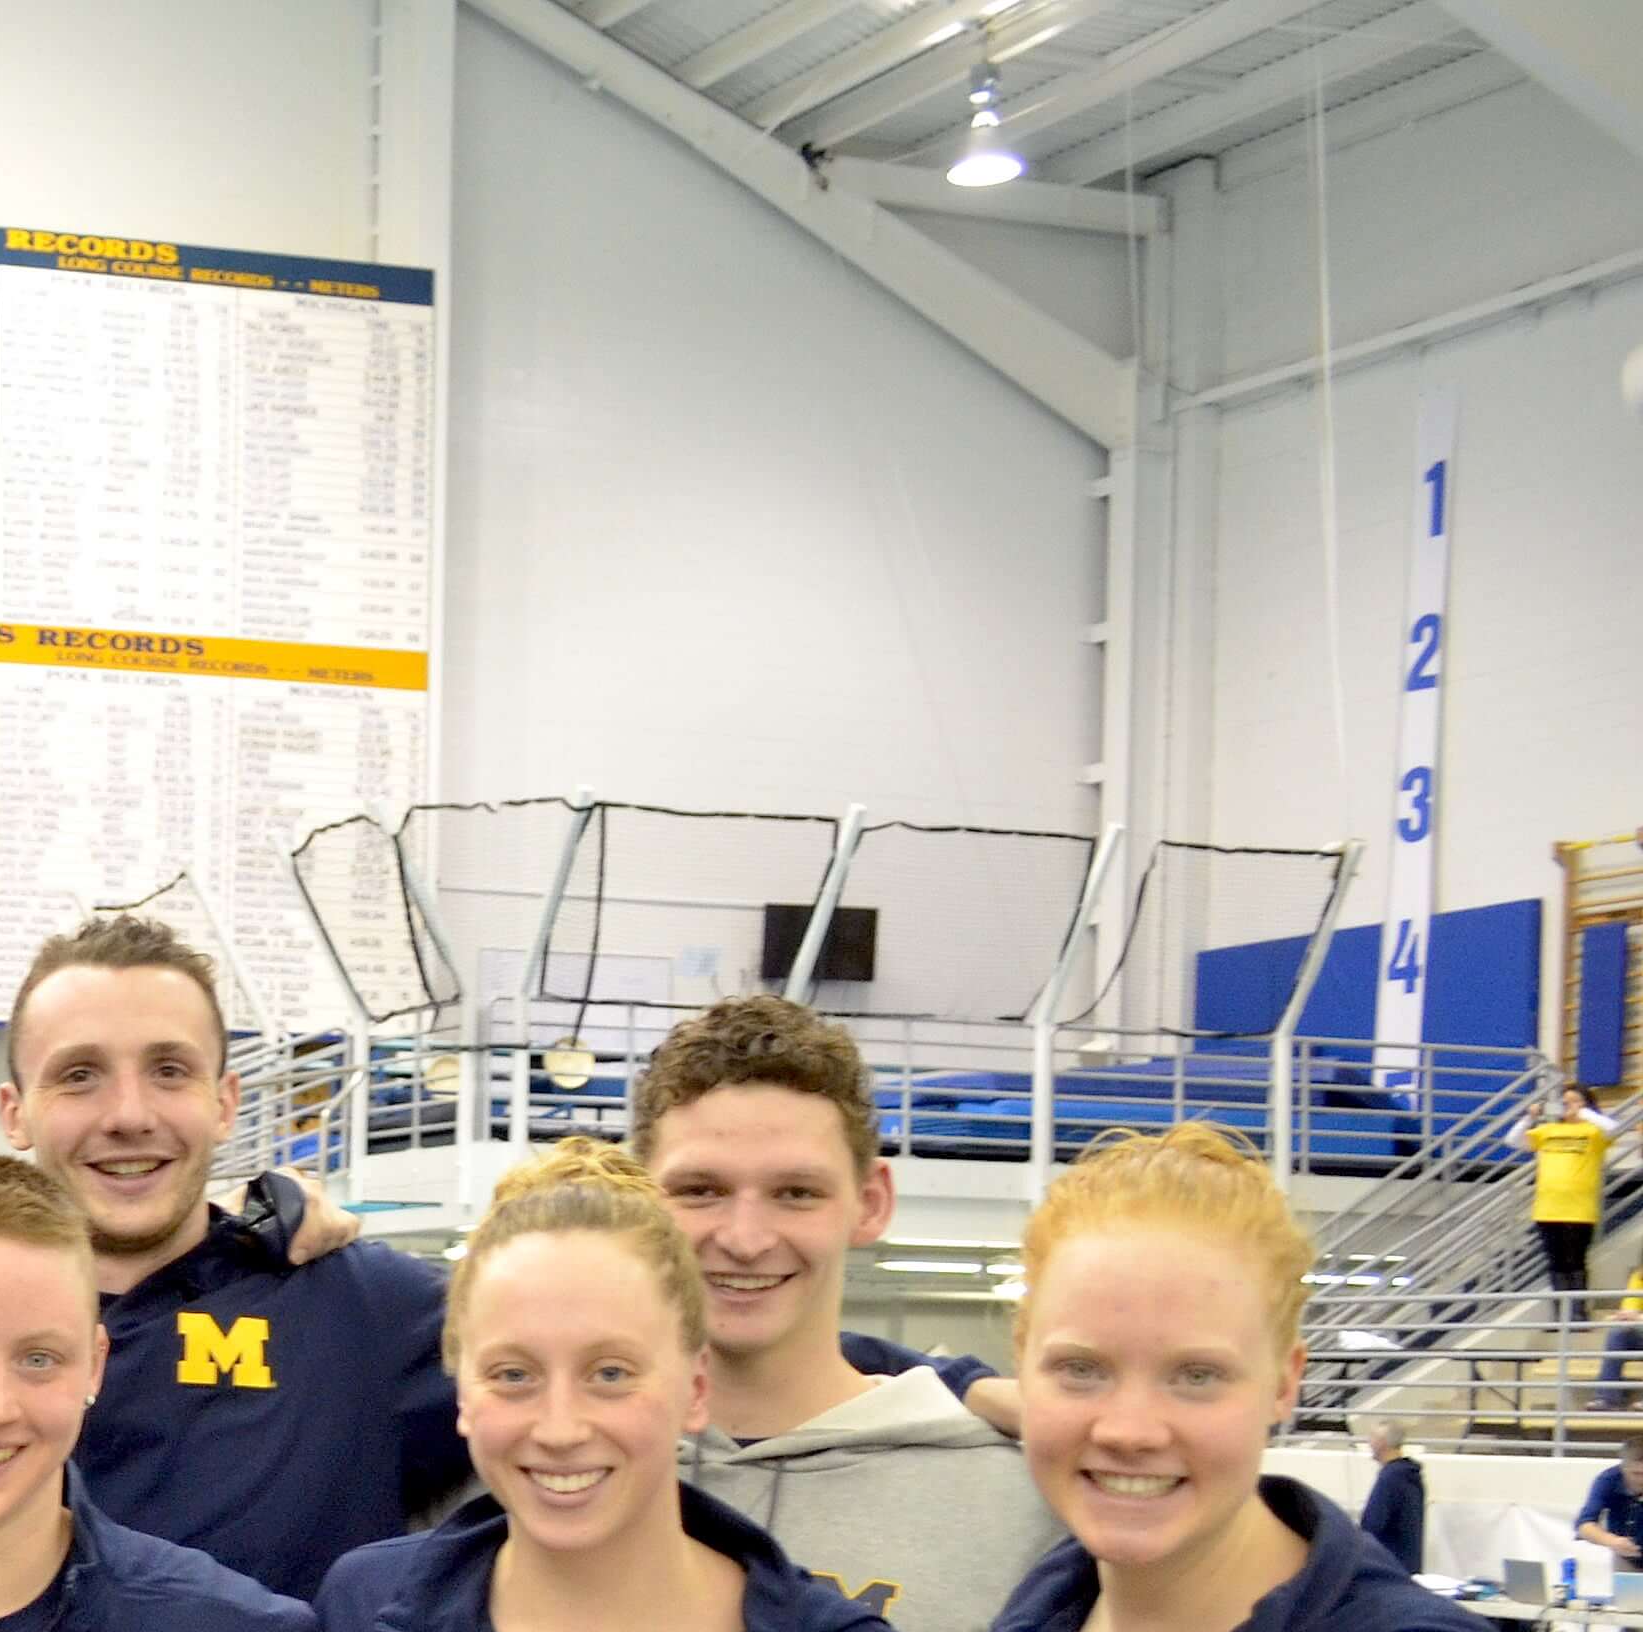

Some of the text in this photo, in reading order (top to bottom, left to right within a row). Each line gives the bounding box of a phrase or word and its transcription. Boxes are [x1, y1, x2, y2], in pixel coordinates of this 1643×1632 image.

[5, 226, 180, 265] RECORDS
[111, 261, 184, 280] COURSE
[190, 268, 274, 289] RECORDS
[1423, 460, 1447, 537] 1
[37, 628, 206, 656] RECORDS
[1405, 613, 1442, 691] 2
[1396, 766, 1434, 842] 3
[1387, 919, 1422, 994] 4
[176, 1312, 278, 1388] M
